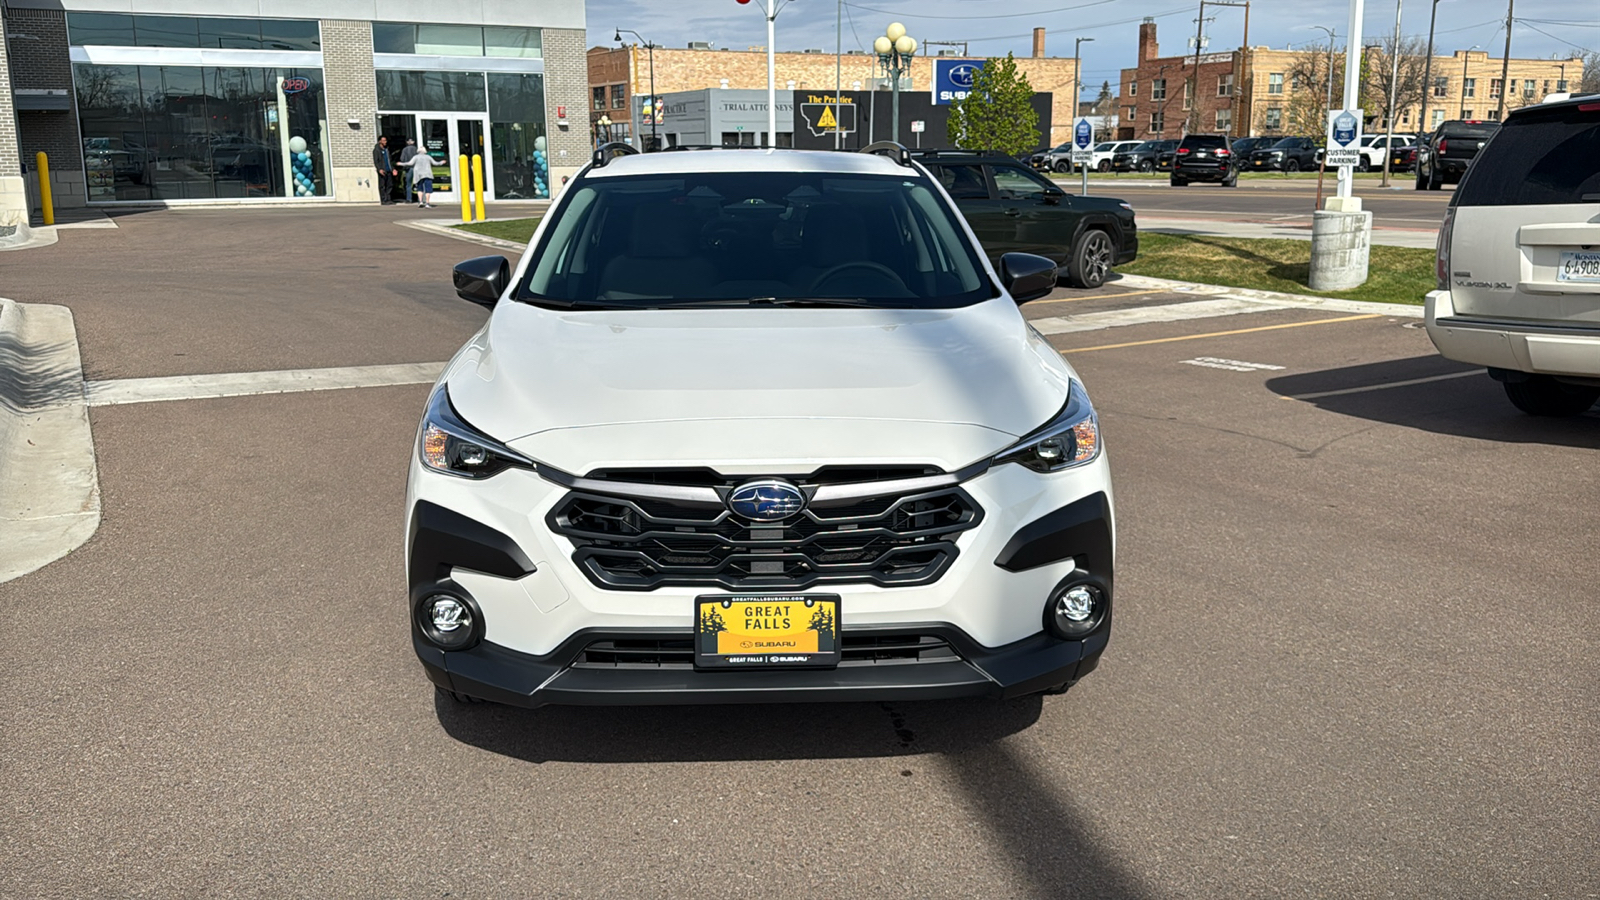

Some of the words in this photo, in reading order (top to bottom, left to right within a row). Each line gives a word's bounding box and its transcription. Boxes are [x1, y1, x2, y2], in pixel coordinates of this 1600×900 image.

[282, 79, 307, 90] OPEN
[807, 95, 822, 103] The
[824, 95, 852, 103] Pratice
[723, 103, 748, 111] TRIAL
[749, 103, 793, 111] ATTONEYS
[745, 606, 791, 617] GREAT
[745, 618, 791, 629] FALLS
